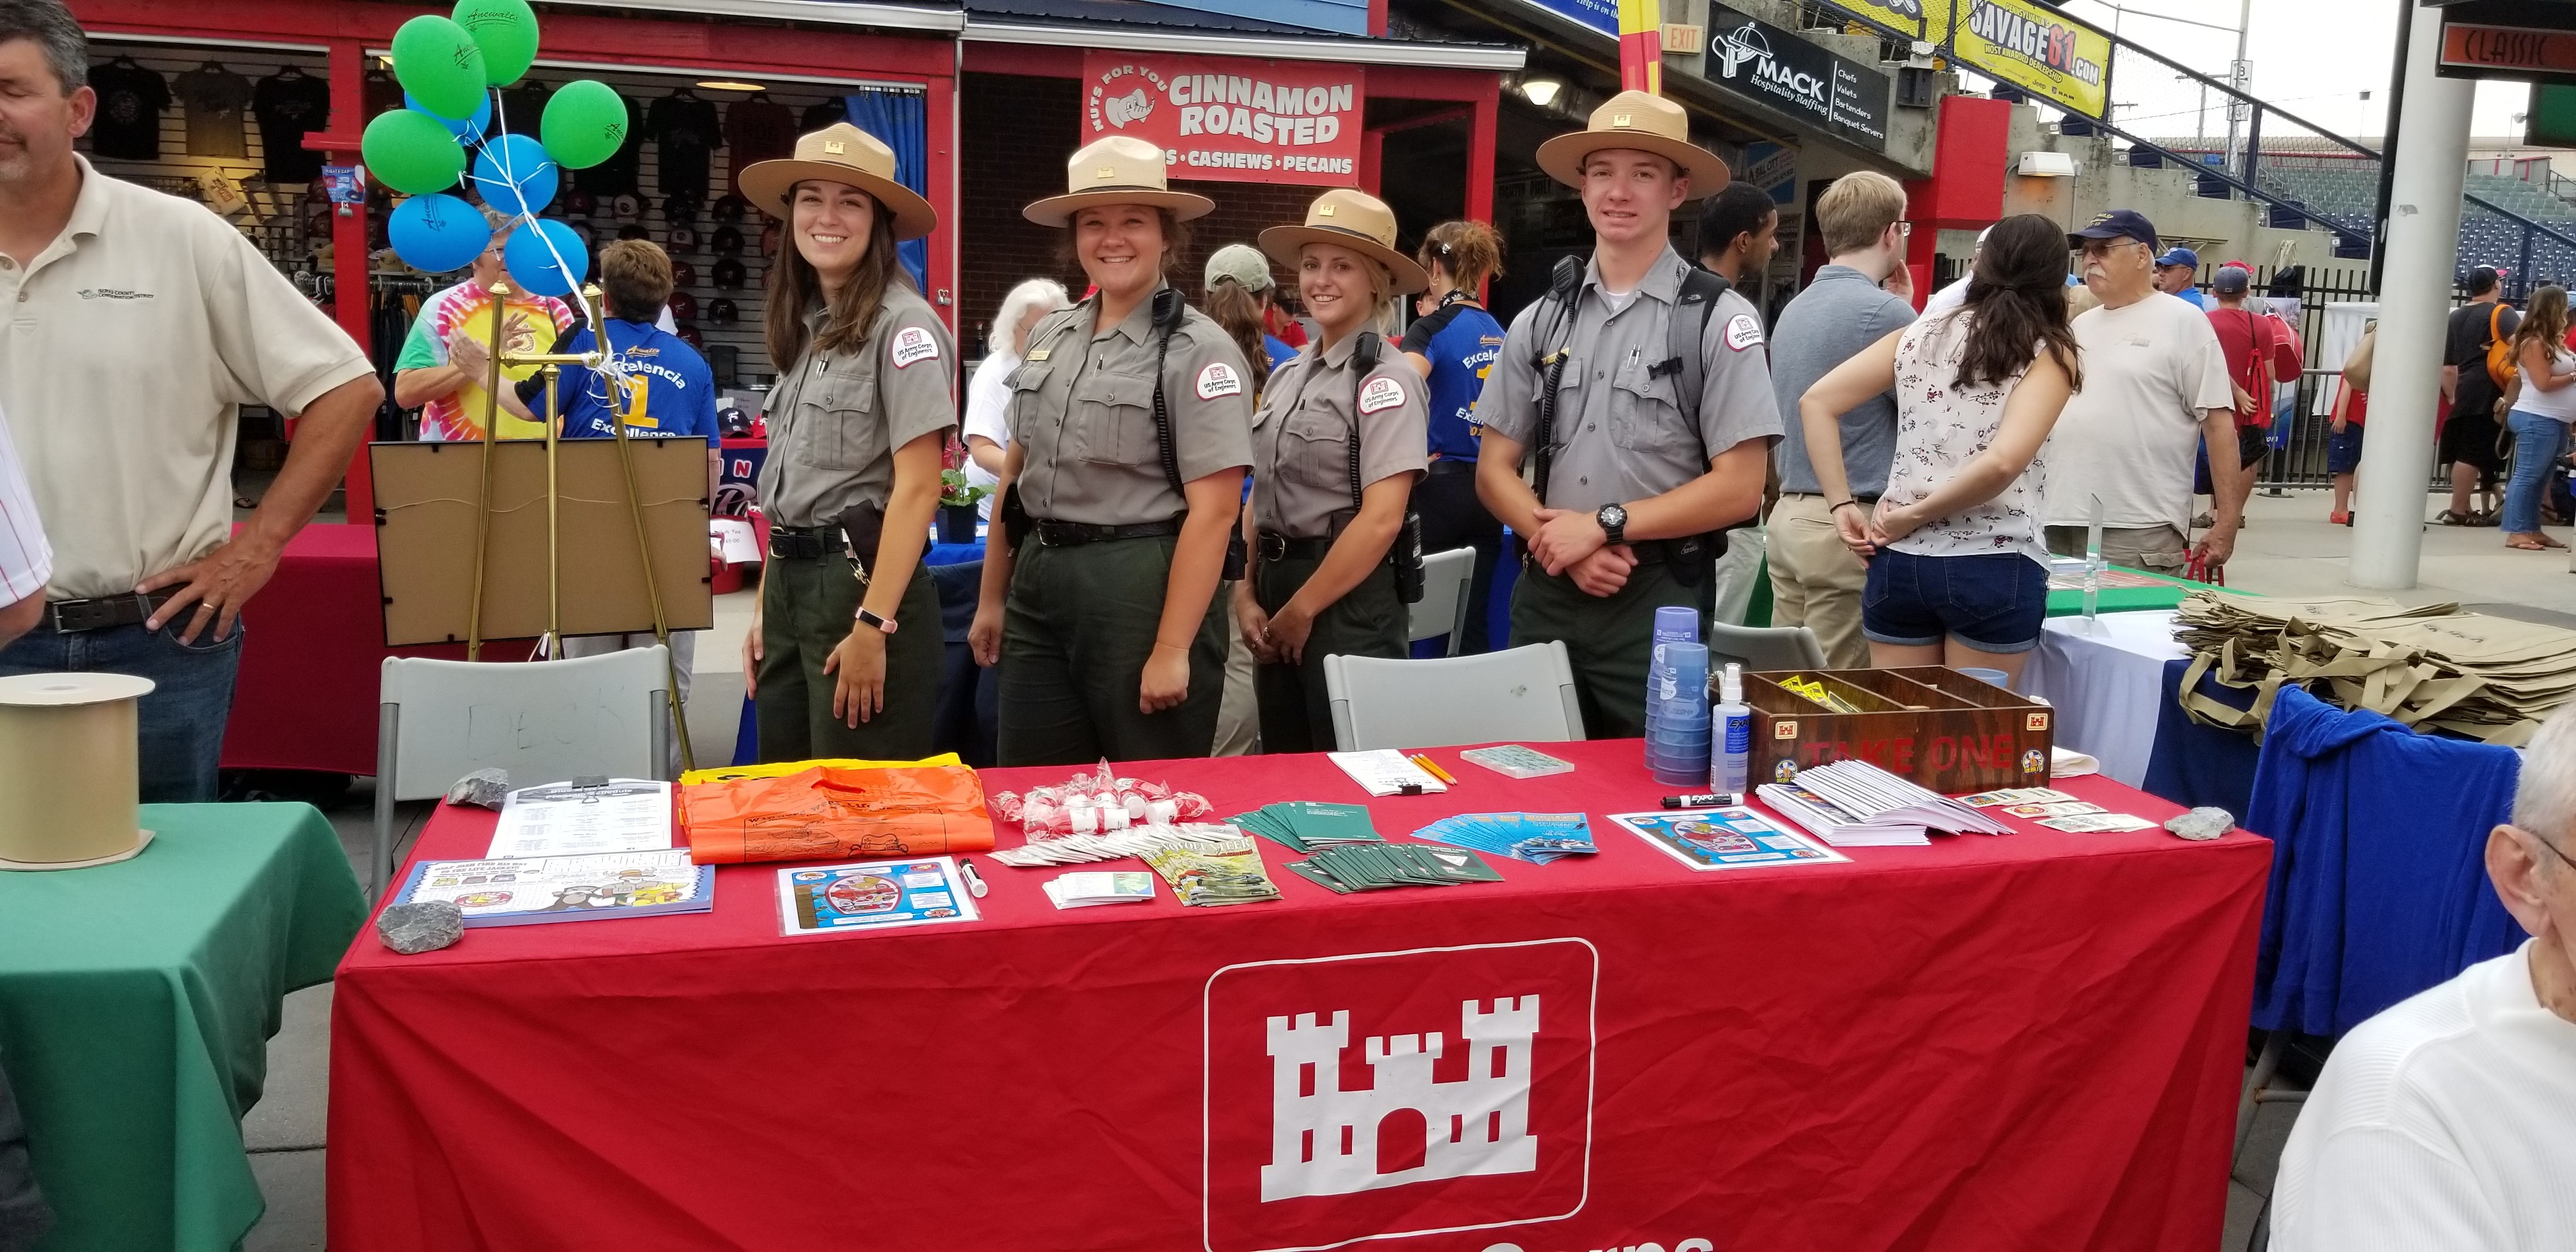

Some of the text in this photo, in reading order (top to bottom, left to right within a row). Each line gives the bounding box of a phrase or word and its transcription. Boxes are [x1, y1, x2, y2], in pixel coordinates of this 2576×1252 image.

[1593, 2, 1599, 11] is
[1600, 6, 1609, 15] on
[2005, 3, 2050, 28] PENNSYLVANIA'S
[1670, 27, 1697, 50] EXIT
[2465, 30, 2548, 65] CLASSIC
[1985, 44, 2001, 55] MOST
[2002, 47, 2028, 65] AWARDED
[2029, 58, 2062, 84] DEALERSHIP
[1756, 56, 1825, 102] MACK
[1838, 70, 1857, 83] Chefs
[2032, 79, 2046, 90] Jeep
[1090, 65, 1168, 132] NUTS FOR YOU
[1169, 74, 1353, 116] CINNAMON
[1751, 74, 1828, 116] Hospitality Staffing
[1837, 84, 1857, 98] Valets
[2058, 91, 2074, 100] RAM
[1836, 98, 1871, 119] Bartenders
[1180, 105, 1339, 146] ROASTED
[1834, 112, 1883, 139] Banquet Servers
[1188, 151, 1272, 170] CASHEWS
[1283, 156, 1352, 174] PECANS
[908, 348, 933, 358] Engineers
[613, 360, 686, 390] celencia
[1374, 397, 1398, 406] Engineers
[1803, 734, 2014, 774] TAKE ONE
[1691, 795, 1714, 804] EXPO
